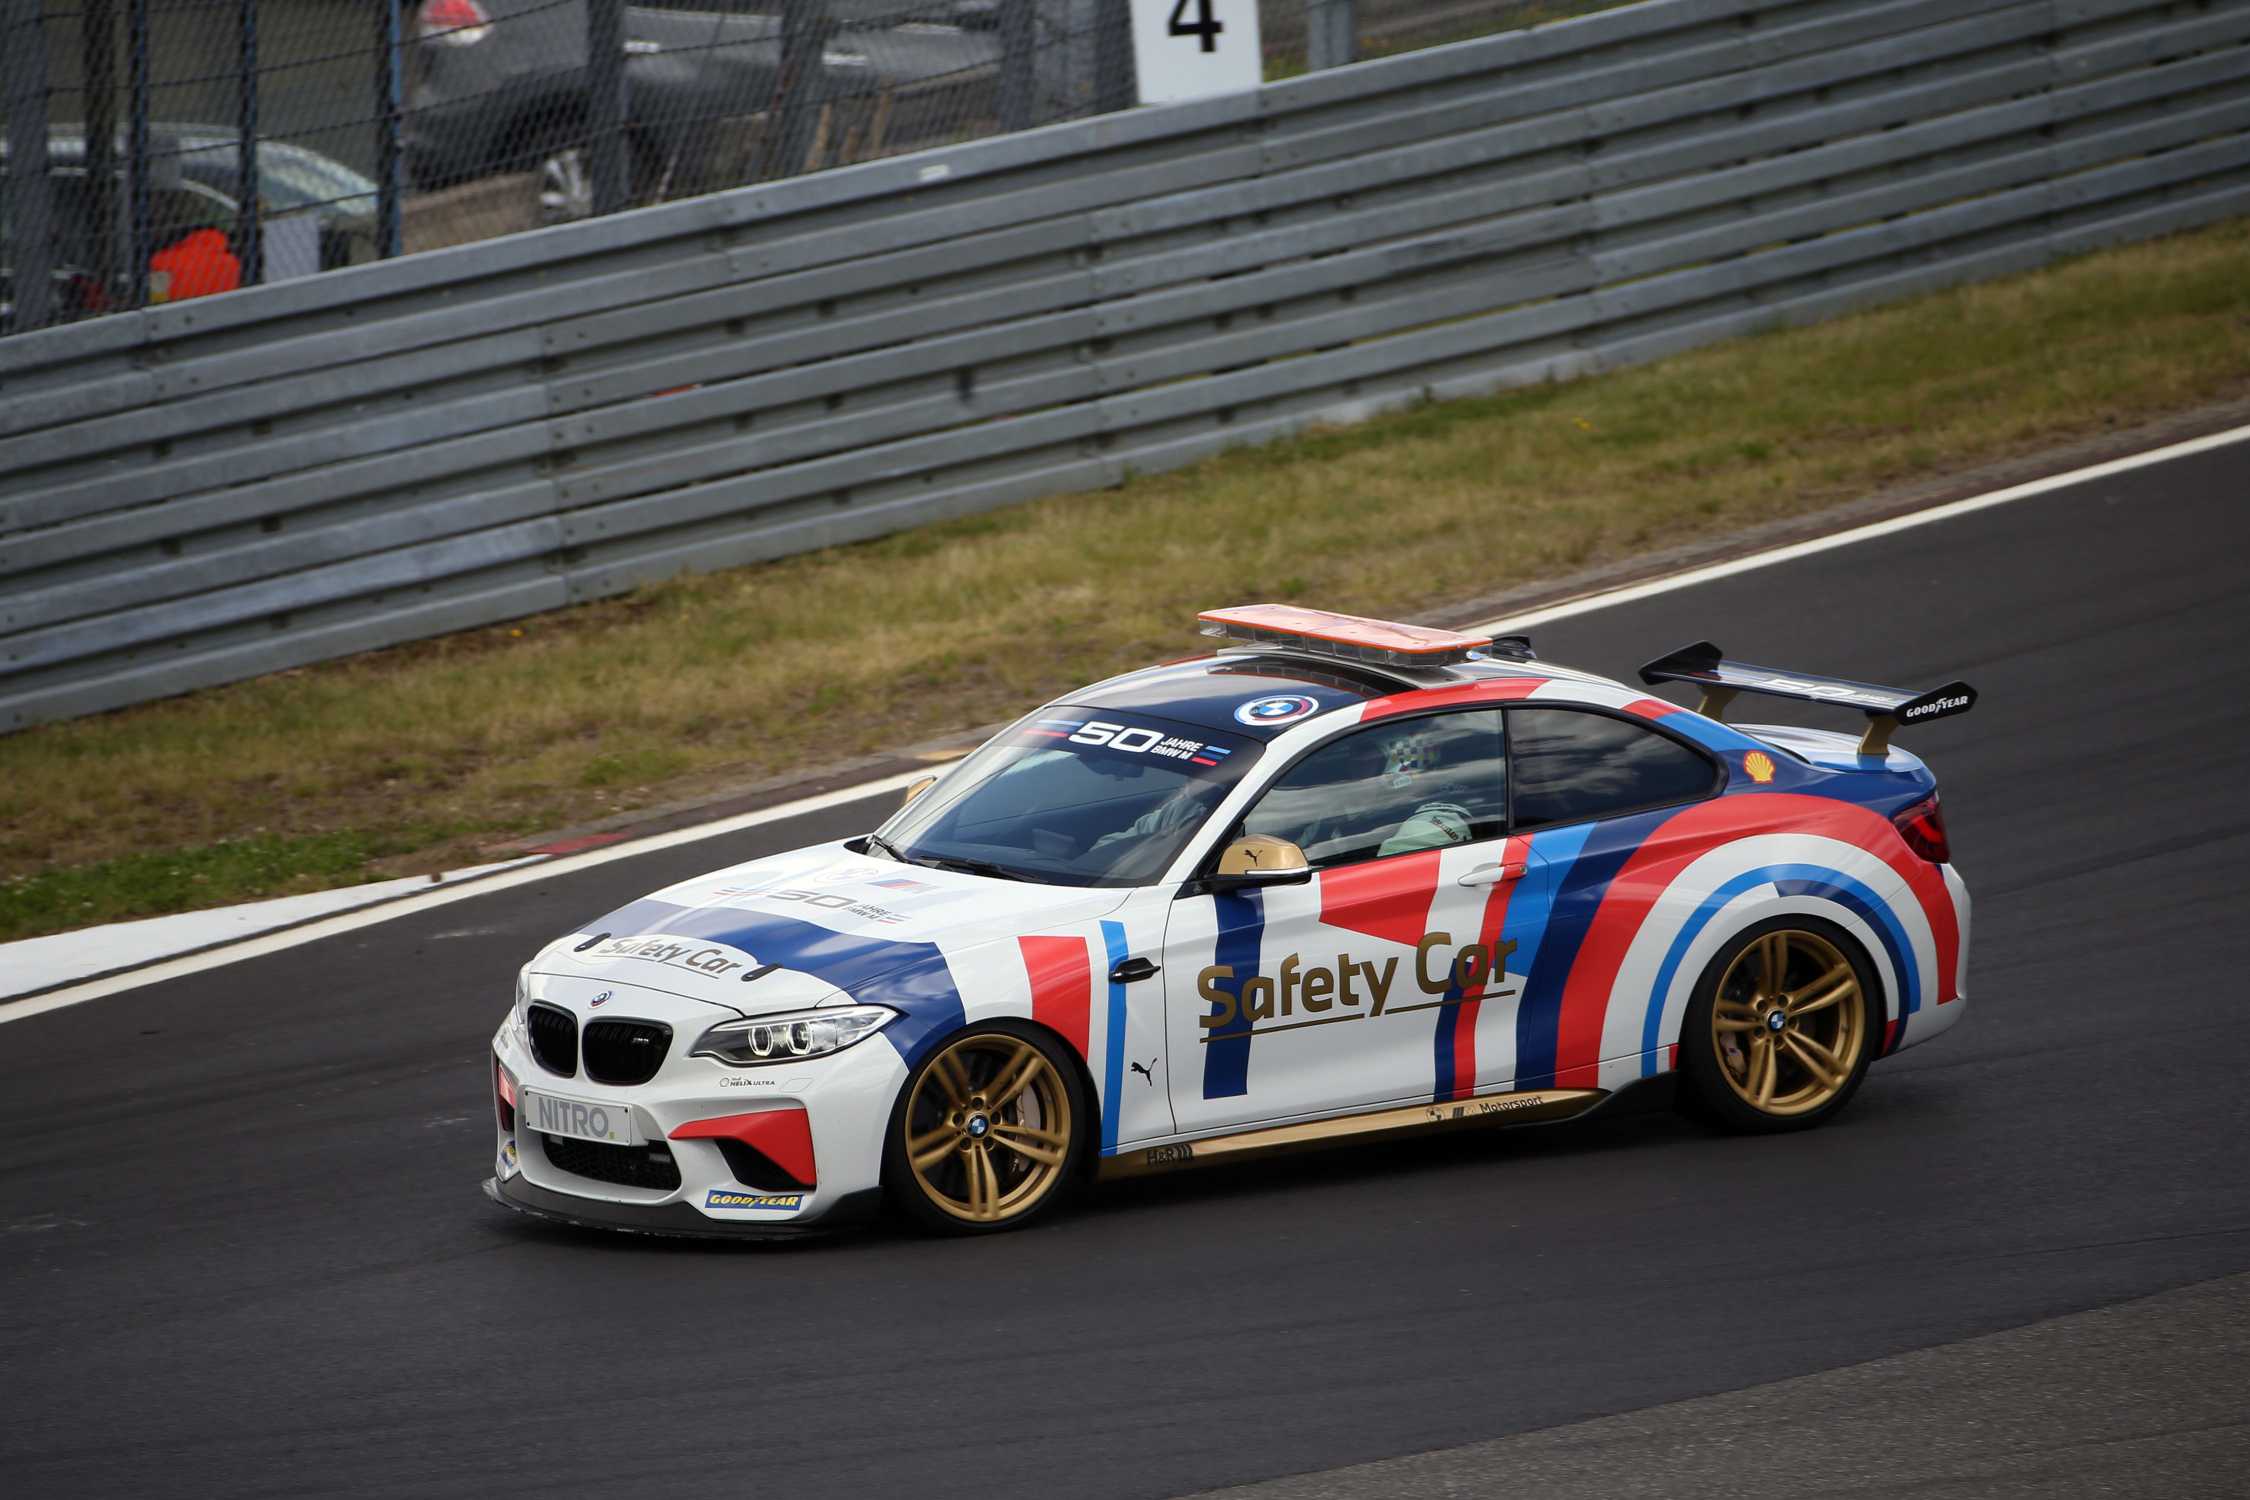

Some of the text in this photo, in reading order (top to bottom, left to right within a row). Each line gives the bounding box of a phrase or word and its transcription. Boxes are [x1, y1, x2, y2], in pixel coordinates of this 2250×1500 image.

[1167, 0, 1224, 53] 4
[1906, 694, 1969, 718] GOODYEAR
[1068, 720, 1165, 753] 50
[1160, 737, 1204, 752] JAHRE
[1150, 744, 1194, 760] BMW M
[766, 889, 858, 909] 50
[598, 938, 743, 975] Safety Car
[1197, 931, 1518, 1028] Safety Car
[1479, 1096, 1543, 1114] Motorsport
[709, 1194, 799, 1208] GOODYEAR
